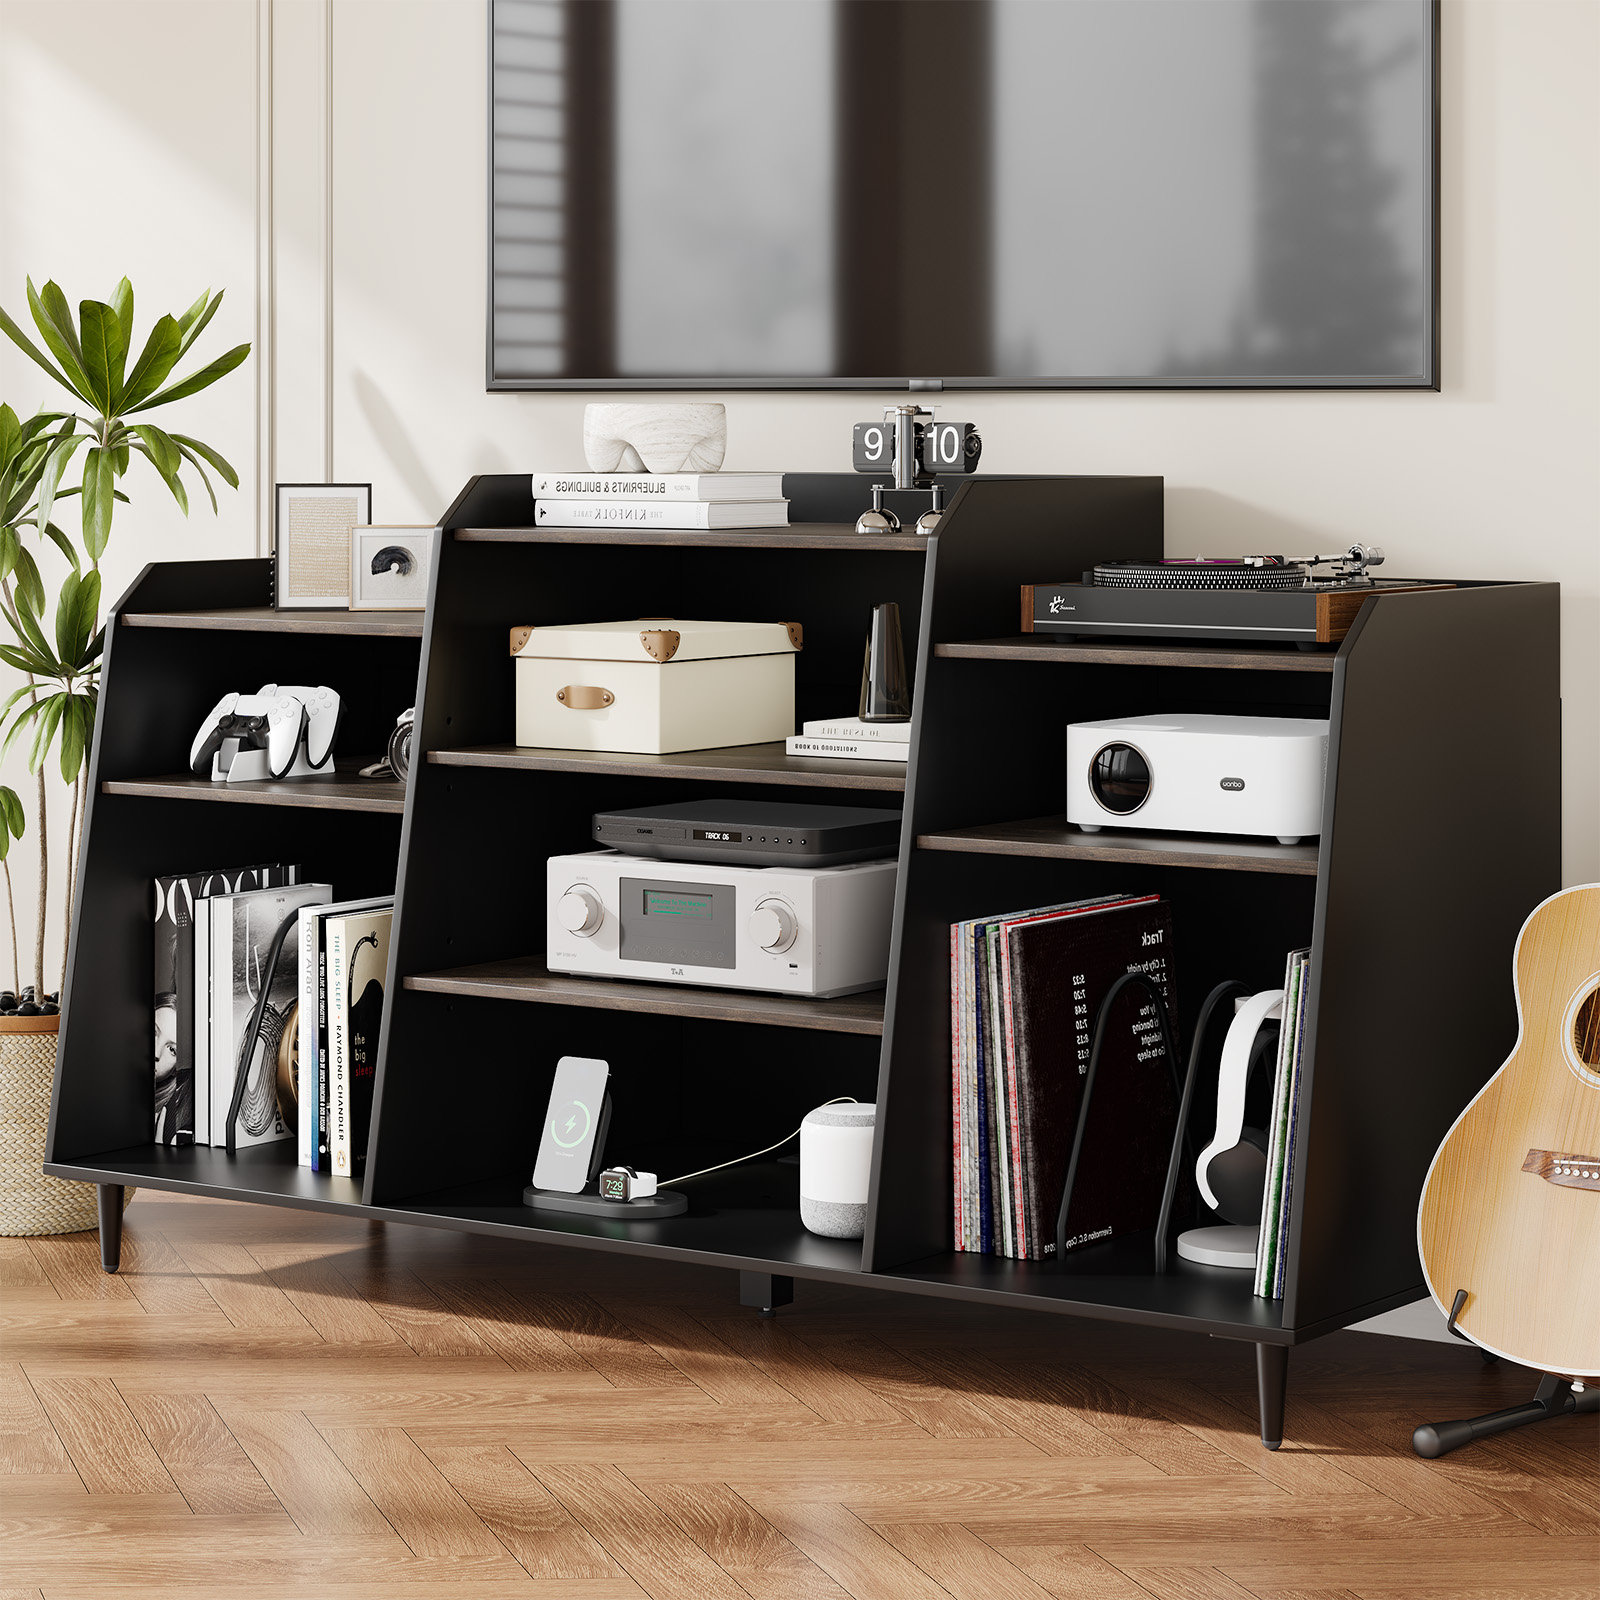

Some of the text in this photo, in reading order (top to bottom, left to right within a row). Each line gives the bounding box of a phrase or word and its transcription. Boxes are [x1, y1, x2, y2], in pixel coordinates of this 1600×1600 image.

[864, 426, 959, 464] 9 10
[354, 1033, 366, 1045] the
[354, 1048, 366, 1063] big
[355, 1064, 373, 1077] sleep
[605, 1180, 624, 1191] 7:29
